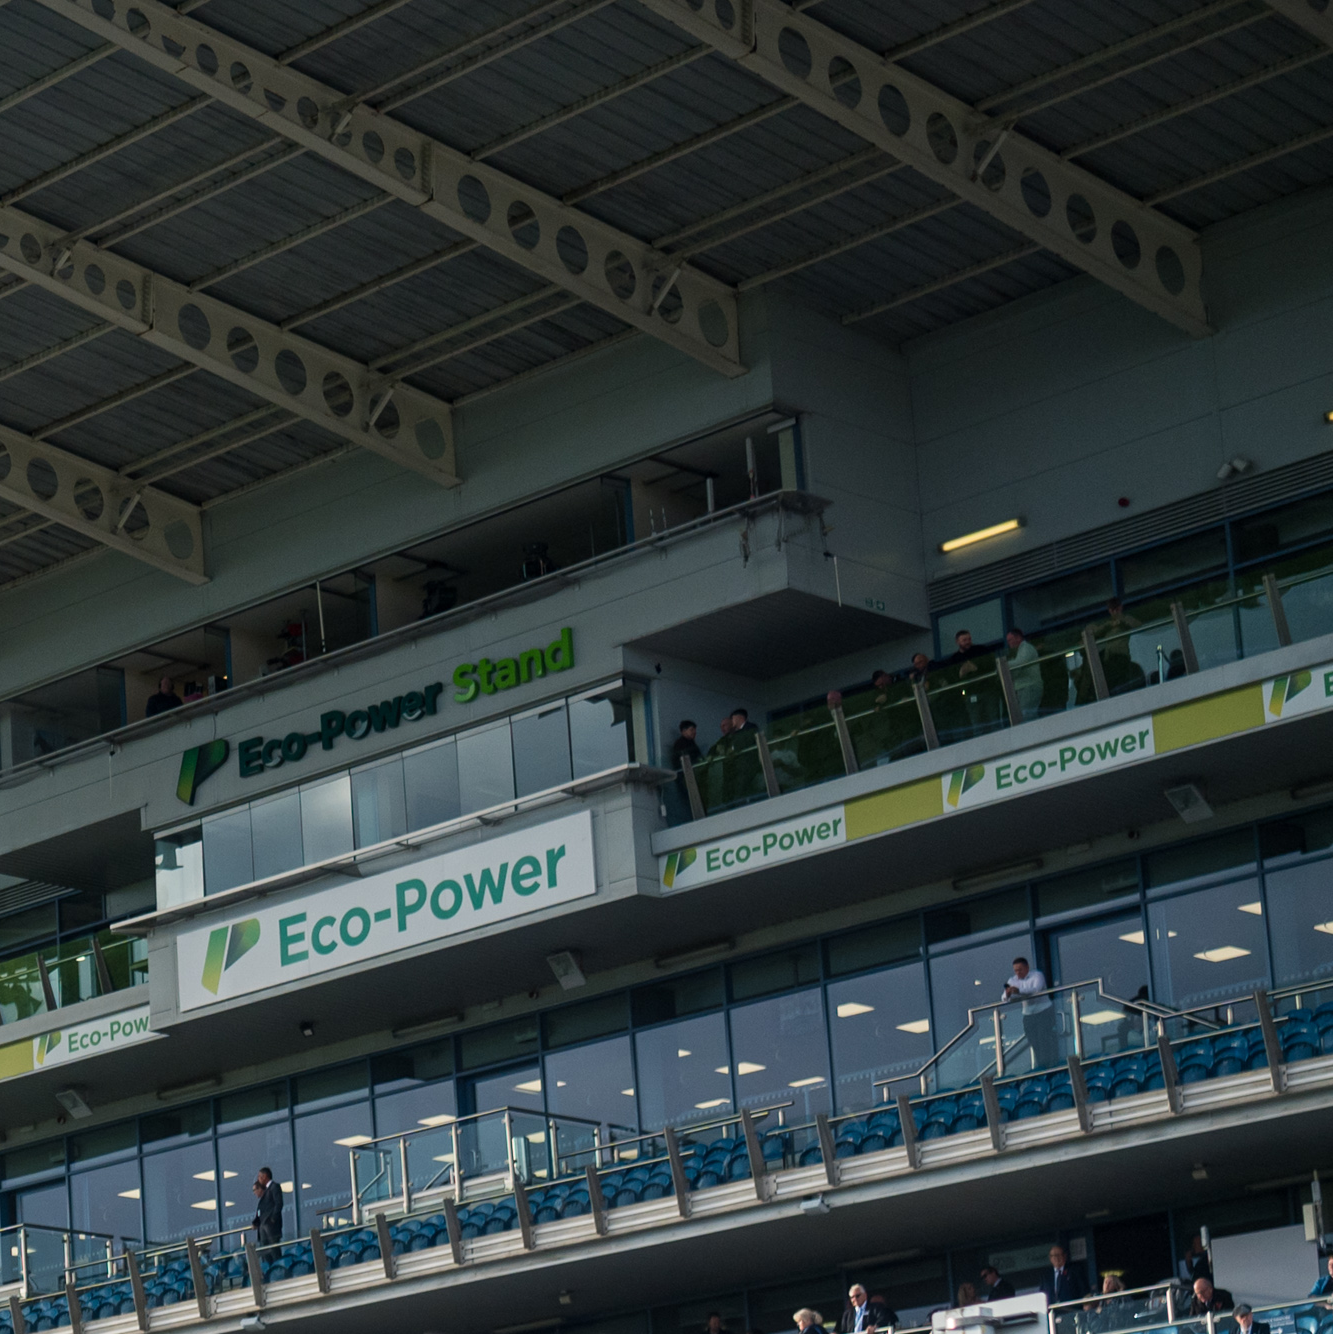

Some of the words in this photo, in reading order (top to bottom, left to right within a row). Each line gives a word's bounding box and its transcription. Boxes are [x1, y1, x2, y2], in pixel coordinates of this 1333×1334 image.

[238, 682, 443, 778] Eco-Power
[452, 626, 575, 703] Stand
[995, 725, 1151, 791] Eco-Power
[705, 815, 843, 872] Eco-Power
[278, 843, 566, 967] Eco-Power
[68, 1014, 150, 1053] Eco-Pow
